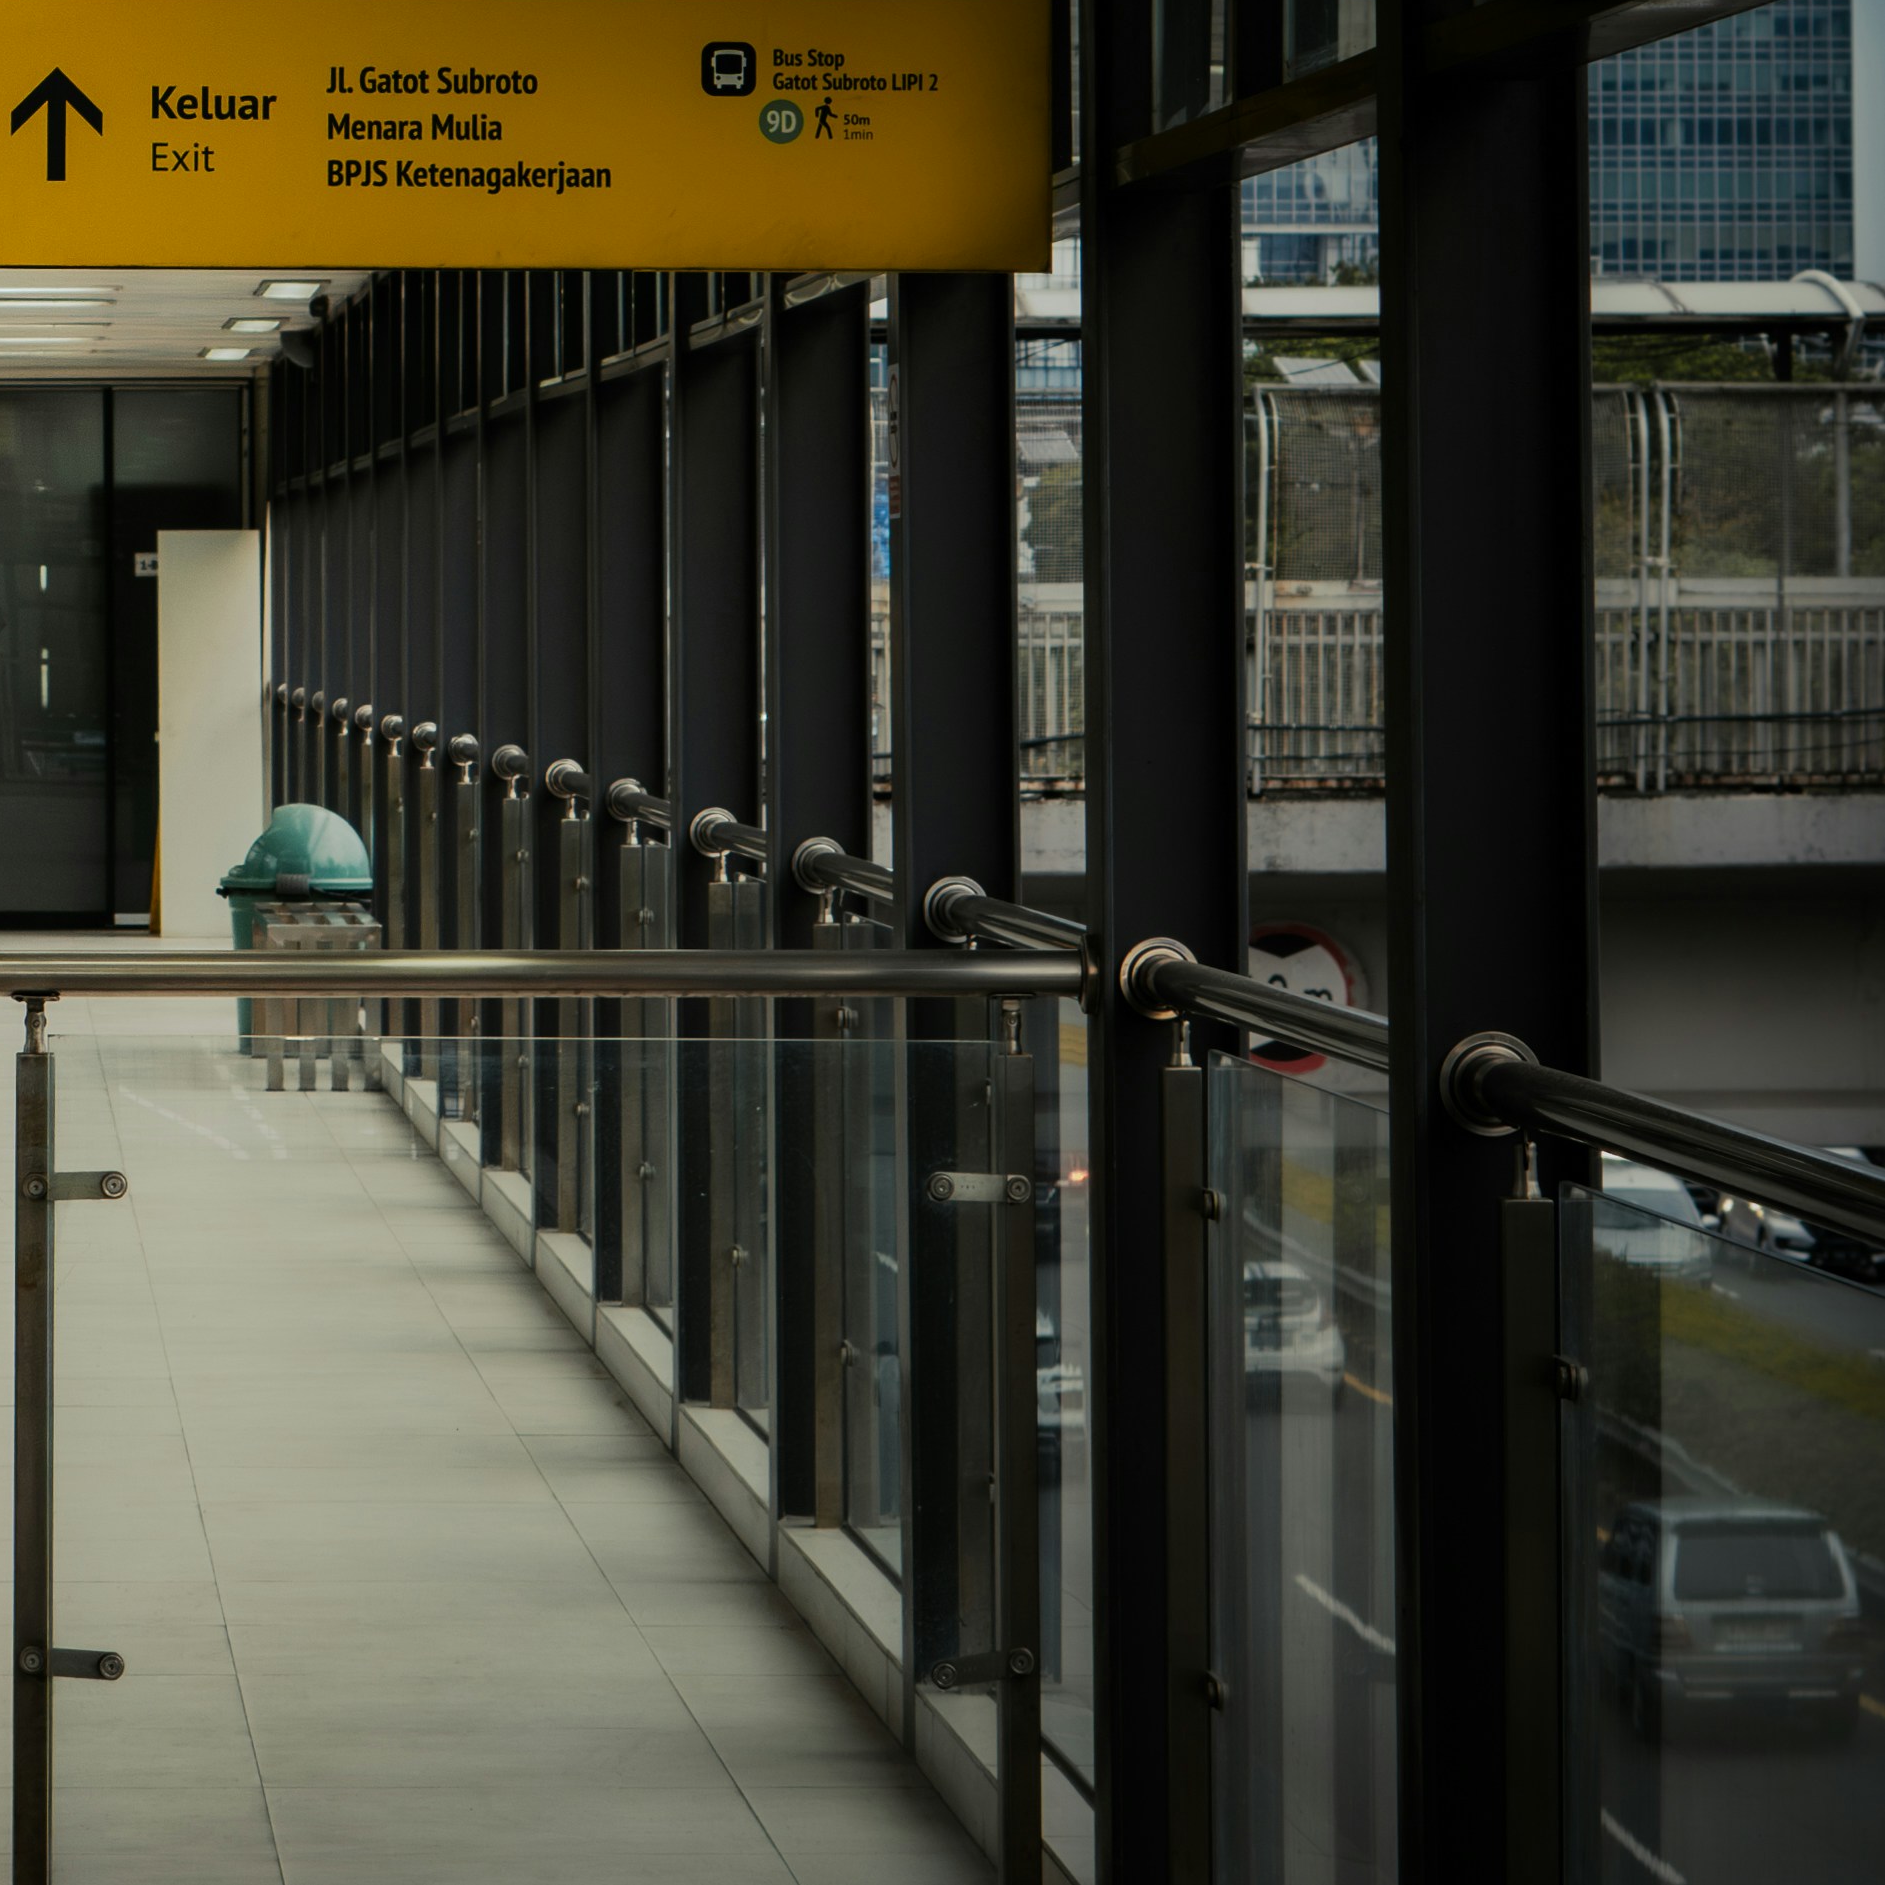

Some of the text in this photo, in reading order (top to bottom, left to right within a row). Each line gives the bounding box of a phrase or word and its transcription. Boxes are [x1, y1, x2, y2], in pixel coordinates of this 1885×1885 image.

[772, 48, 845, 72] Bus Stop
[326, 66, 538, 95] Jl. Gatot Subroto
[772, 72, 939, 92] Gatot Subroto LIPI 2
[151, 85, 278, 121] Keluar
[327, 112, 502, 141] Menara Mulia
[766, 109, 797, 134] 9D
[843, 114, 871, 126] 50m
[843, 128, 874, 140] 1min
[151, 142, 215, 173] Exit
[327, 159, 612, 195] BPJS Ketenagakerjaan
